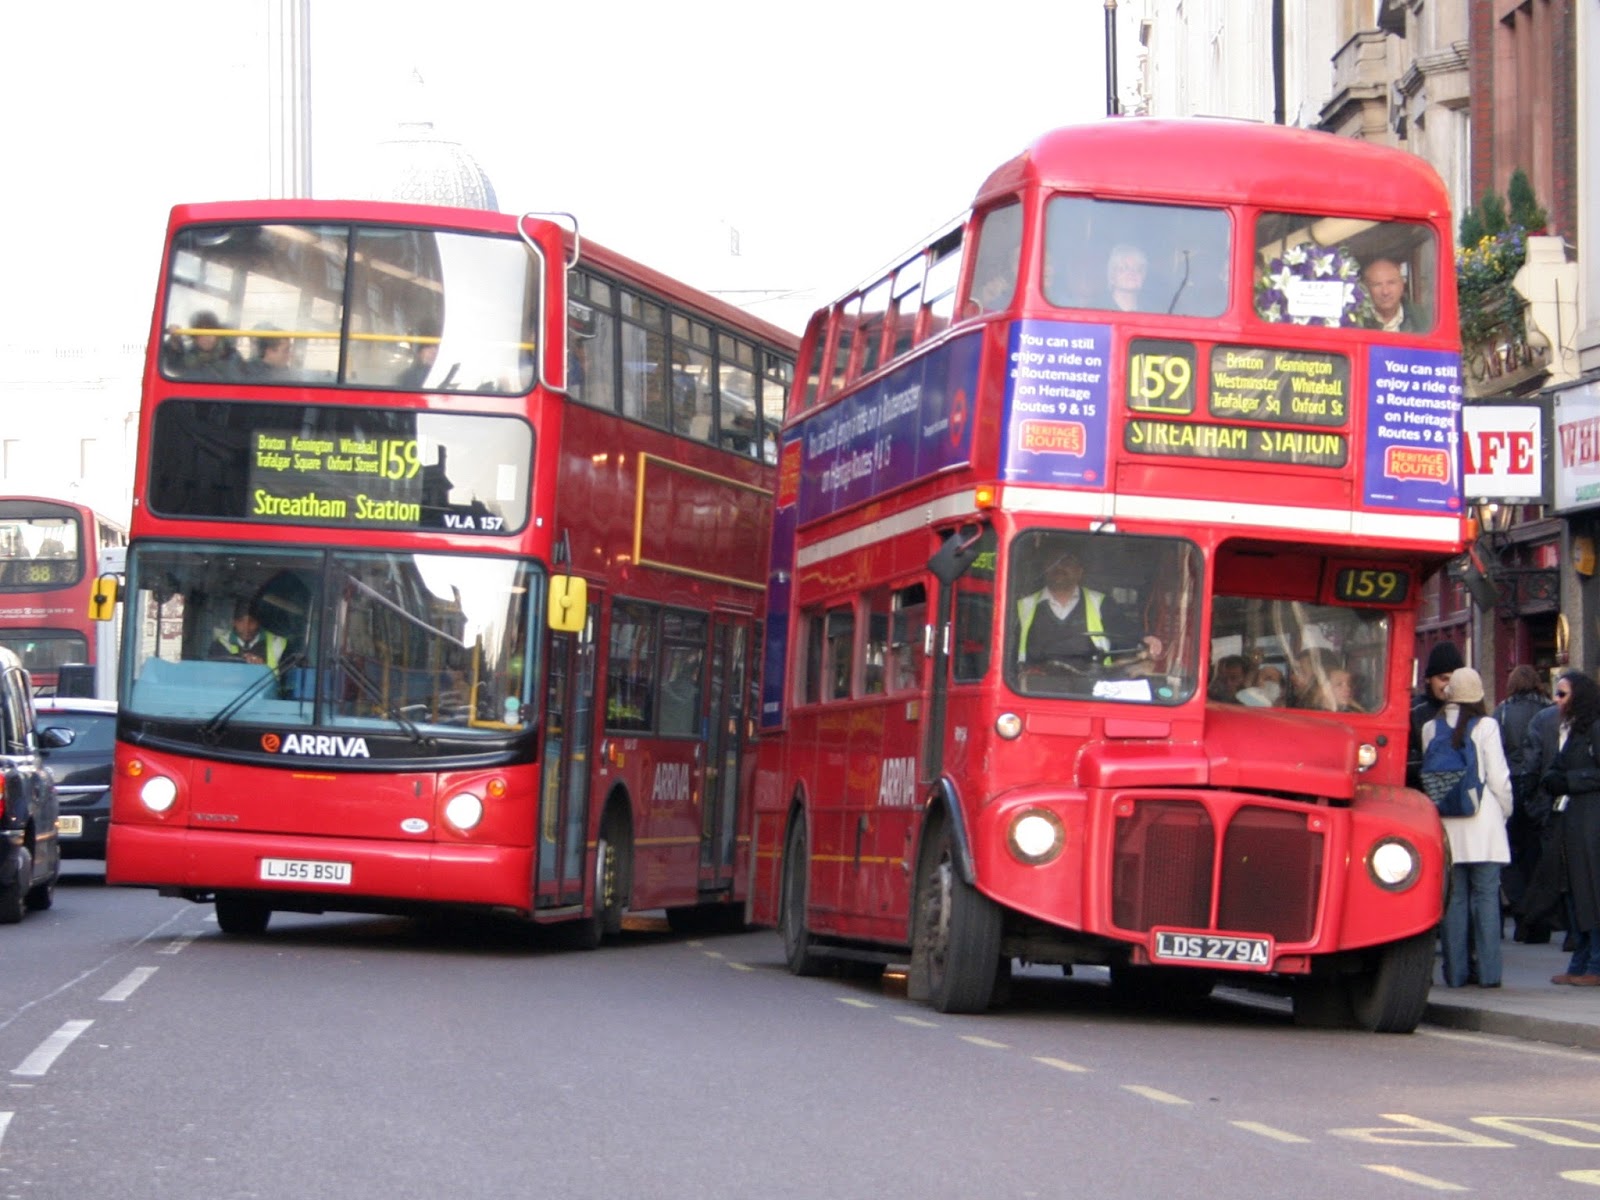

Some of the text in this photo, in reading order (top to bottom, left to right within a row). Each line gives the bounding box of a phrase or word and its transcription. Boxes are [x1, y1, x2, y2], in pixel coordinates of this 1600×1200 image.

[1020, 333, 1095, 350] You can still
[1011, 351, 1102, 367] enjoy a ride on
[1226, 352, 1333, 377] Brixton Kennington
[1011, 367, 1101, 383] a Routemaster
[1130, 354, 1192, 400] 159
[1385, 360, 1457, 378] You can still
[1019, 384, 1091, 401] on Heritage
[1213, 372, 1343, 396] Westminster Whitehall
[1376, 378, 1462, 395] enjoy a ride on
[1012, 400, 1096, 416] Routes 9 & 15
[1213, 391, 1344, 416] Trafalgar Sq Oxford St
[1376, 393, 1462, 412] a Routemaster
[1384, 411, 1456, 428] on Heritage
[1025, 424, 1080, 437] HERITAGE
[1131, 422, 1340, 455] STREATHAM STATION
[1378, 425, 1459, 444] Routes 9 & 15
[291, 435, 335, 456] Kennington
[340, 438, 378, 456] Whitehall
[1025, 435, 1081, 451] ROUTES
[256, 451, 292, 472] Trafalgar
[293, 453, 322, 474] Square
[326, 454, 353, 473] Oxford
[380, 438, 421, 480] 159
[1391, 450, 1444, 465] HERITAGE
[1391, 461, 1445, 478] ROUTES
[253, 489, 421, 522] Streatham Station
[444, 515, 504, 531] VLA 157
[1345, 570, 1397, 598] 159
[281, 733, 371, 758] ARRIVA
[652, 762, 690, 801] ARRIVA
[878, 756, 916, 806] ARRIVA
[267, 861, 345, 881] LJ55 BSU
[1158, 934, 1268, 963] LDS 279A
